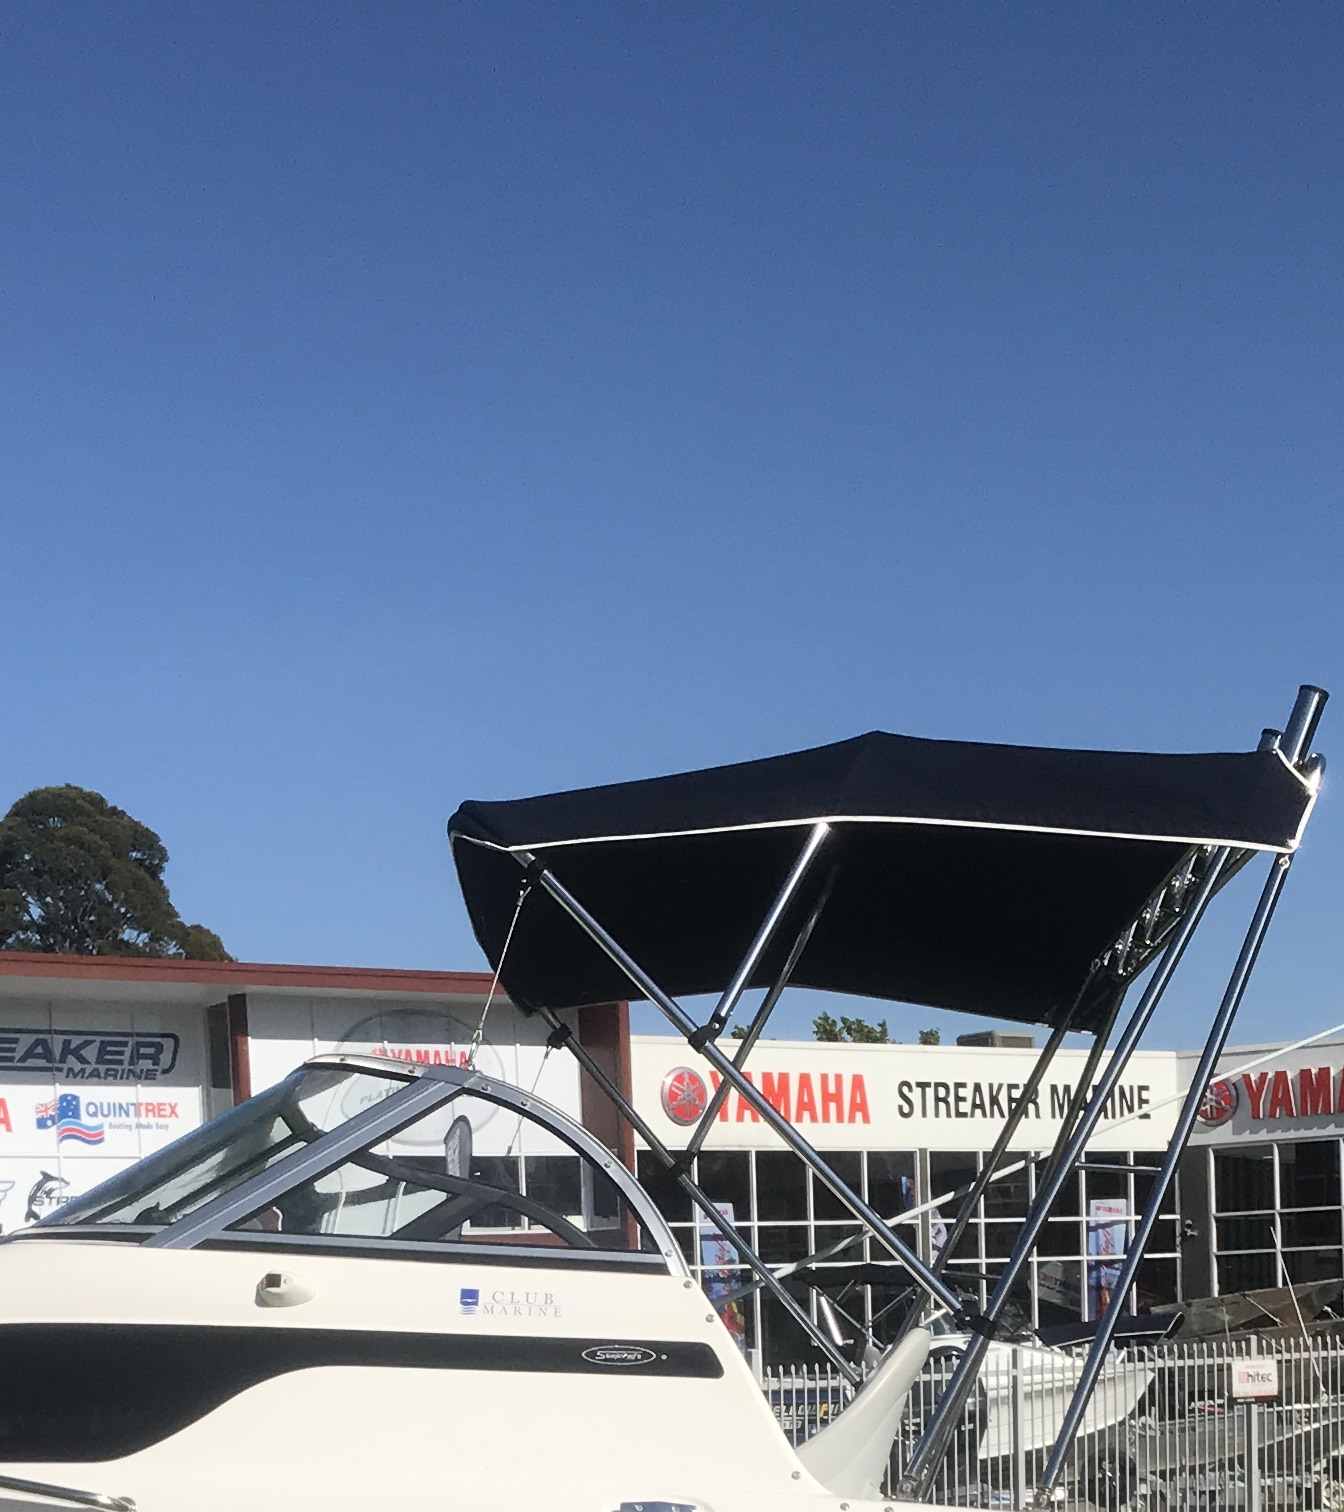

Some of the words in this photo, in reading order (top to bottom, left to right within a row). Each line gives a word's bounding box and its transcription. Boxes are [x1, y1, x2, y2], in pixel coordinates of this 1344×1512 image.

[65, 1066, 159, 1081] MARINE
[709, 1070, 871, 1124] YAMAHA
[897, 1080, 1042, 1120] STREAKER
[85, 1101, 180, 1119] QUINTREX
[491, 1290, 555, 1305] CLUB
[482, 1304, 562, 1317] MARINE
